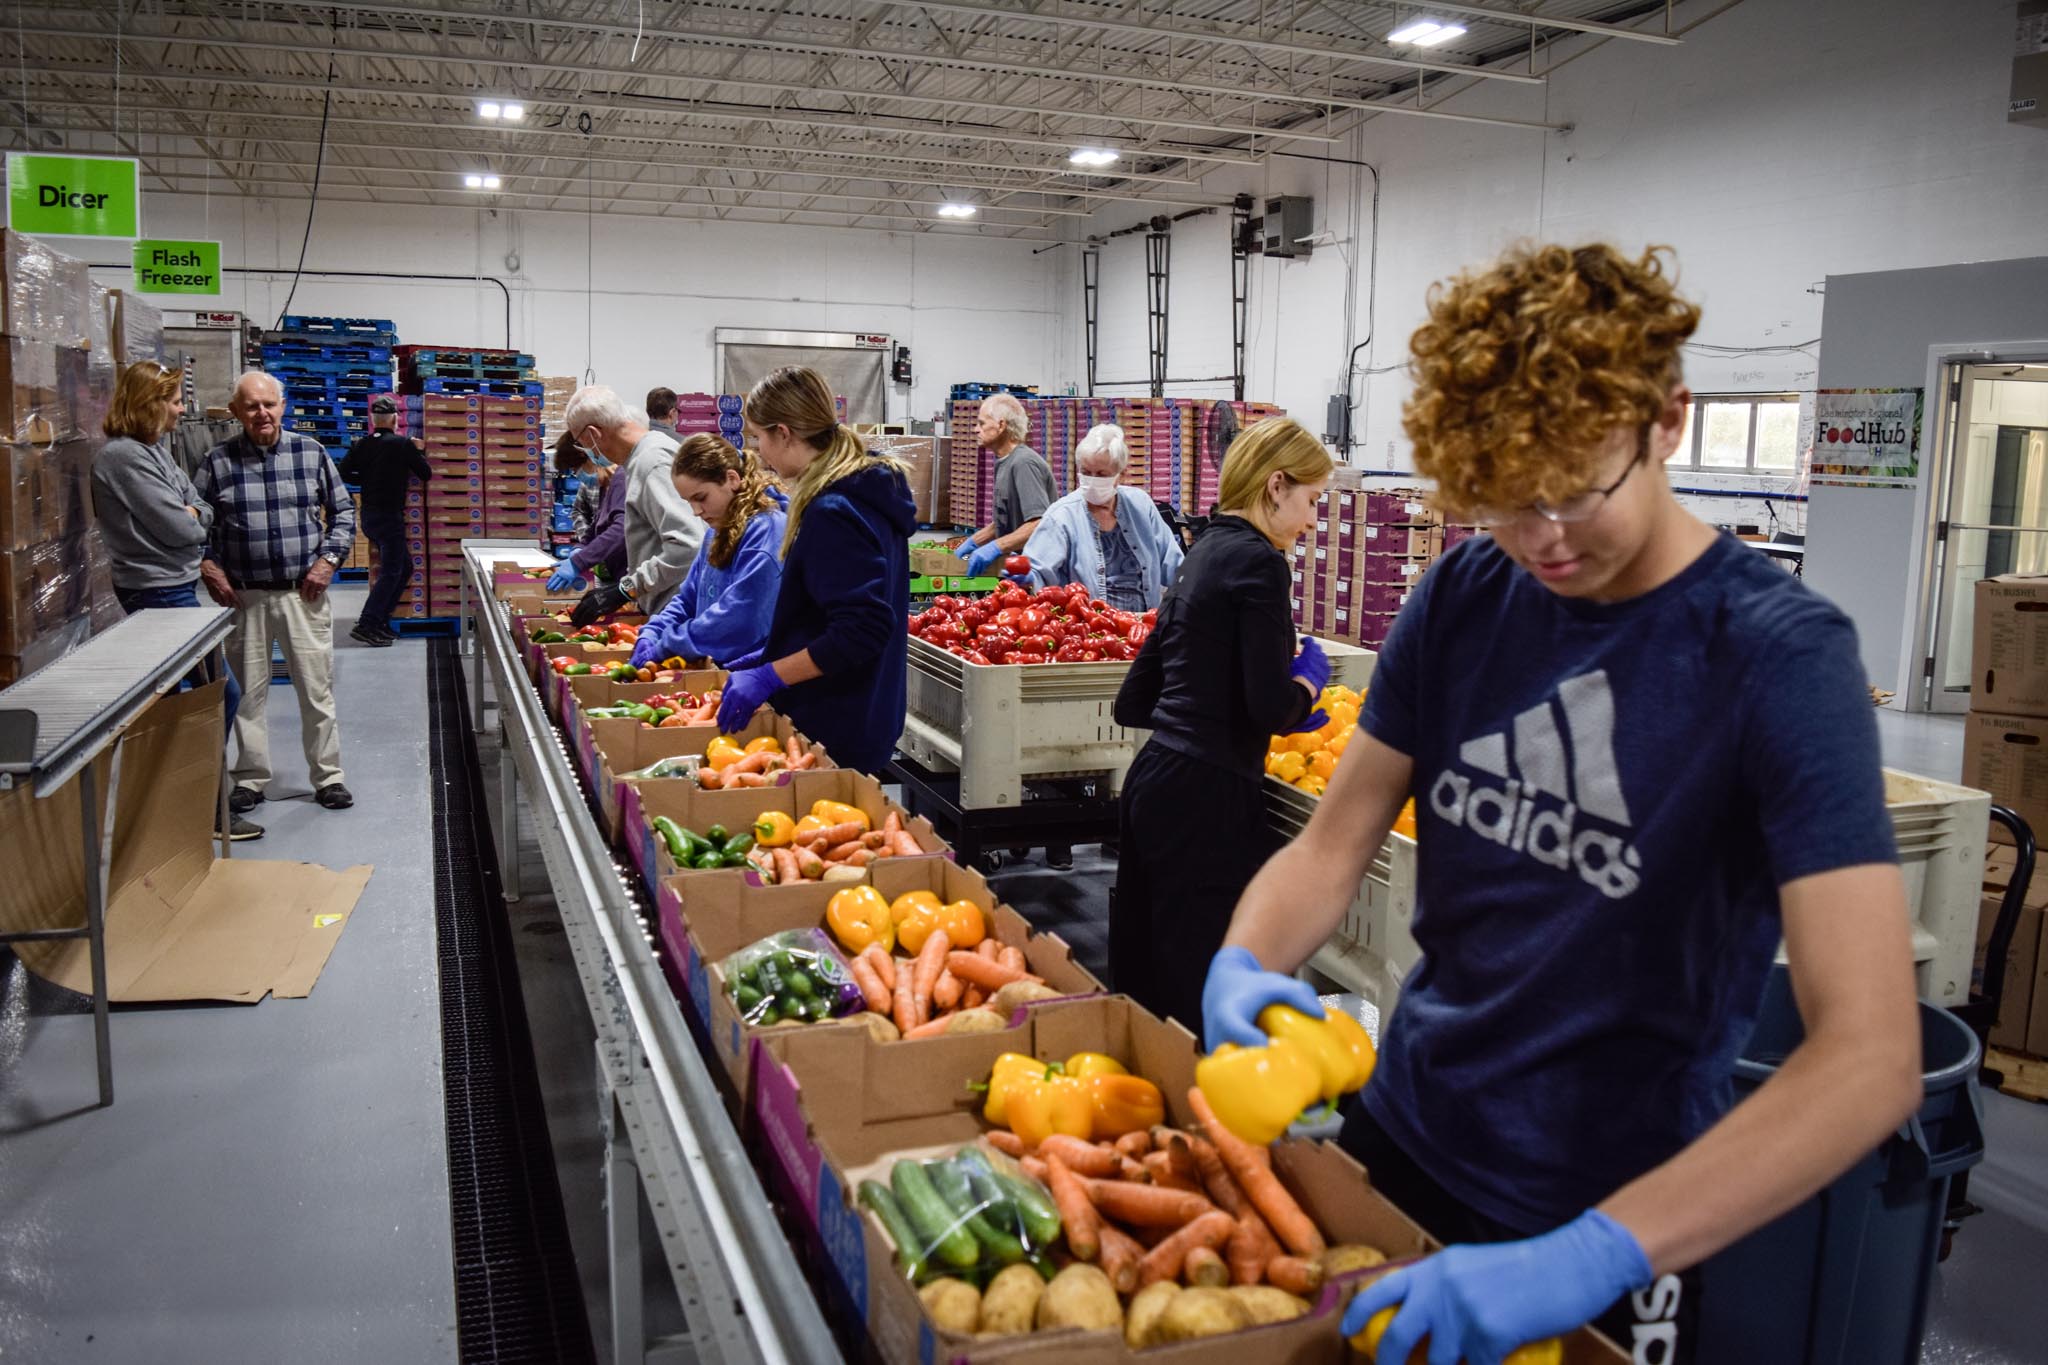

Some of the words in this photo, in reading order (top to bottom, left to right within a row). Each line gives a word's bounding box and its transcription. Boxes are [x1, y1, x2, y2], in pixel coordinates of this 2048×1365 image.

[2010, 100, 2035, 111] ALLIED
[38, 184, 108, 210] Dicer
[152, 249, 200, 267] Flash
[141, 268, 212, 287] Freezer
[1993, 718, 2026, 730] BUSHEL
[1430, 769, 1642, 899] adidas
